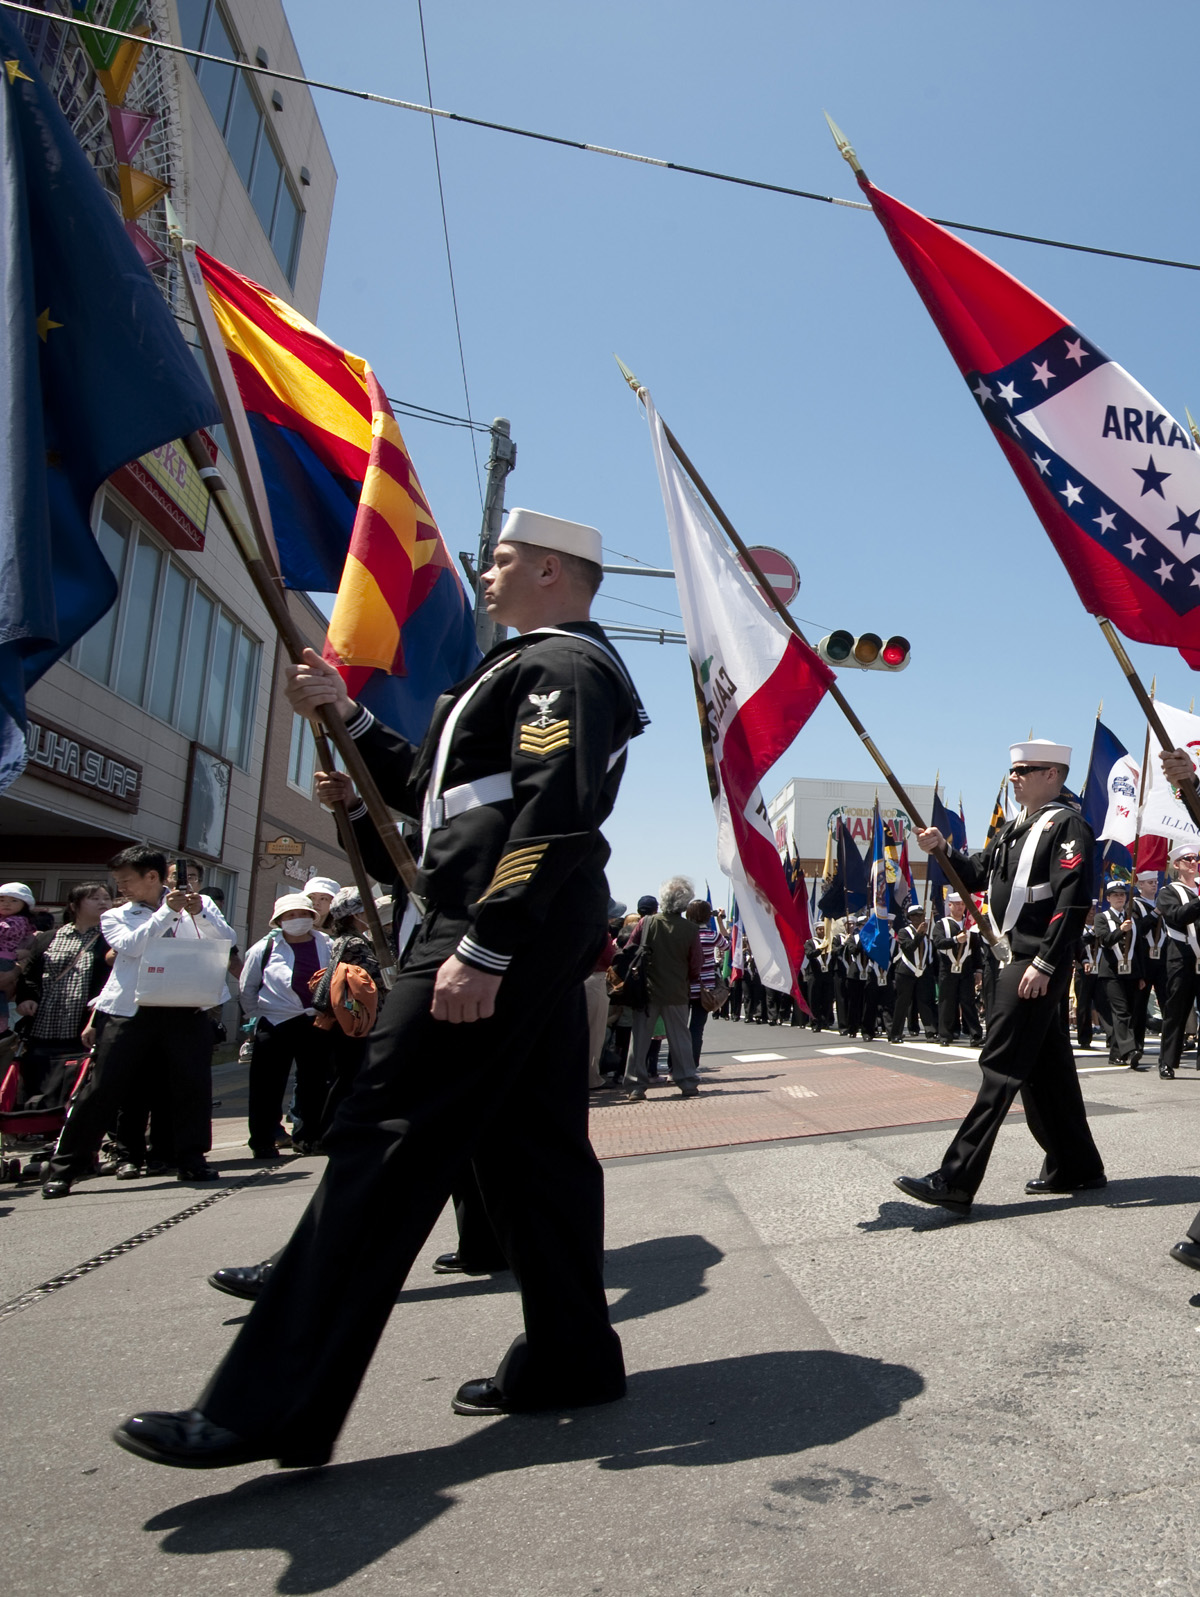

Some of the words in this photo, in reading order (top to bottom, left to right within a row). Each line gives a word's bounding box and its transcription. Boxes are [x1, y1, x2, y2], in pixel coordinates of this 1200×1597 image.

[1102, 404, 1196, 451] ARKA
[82, 750, 138, 798] SURF
[844, 807, 870, 817] WORLD
[870, 808, 897, 818] LUOR
